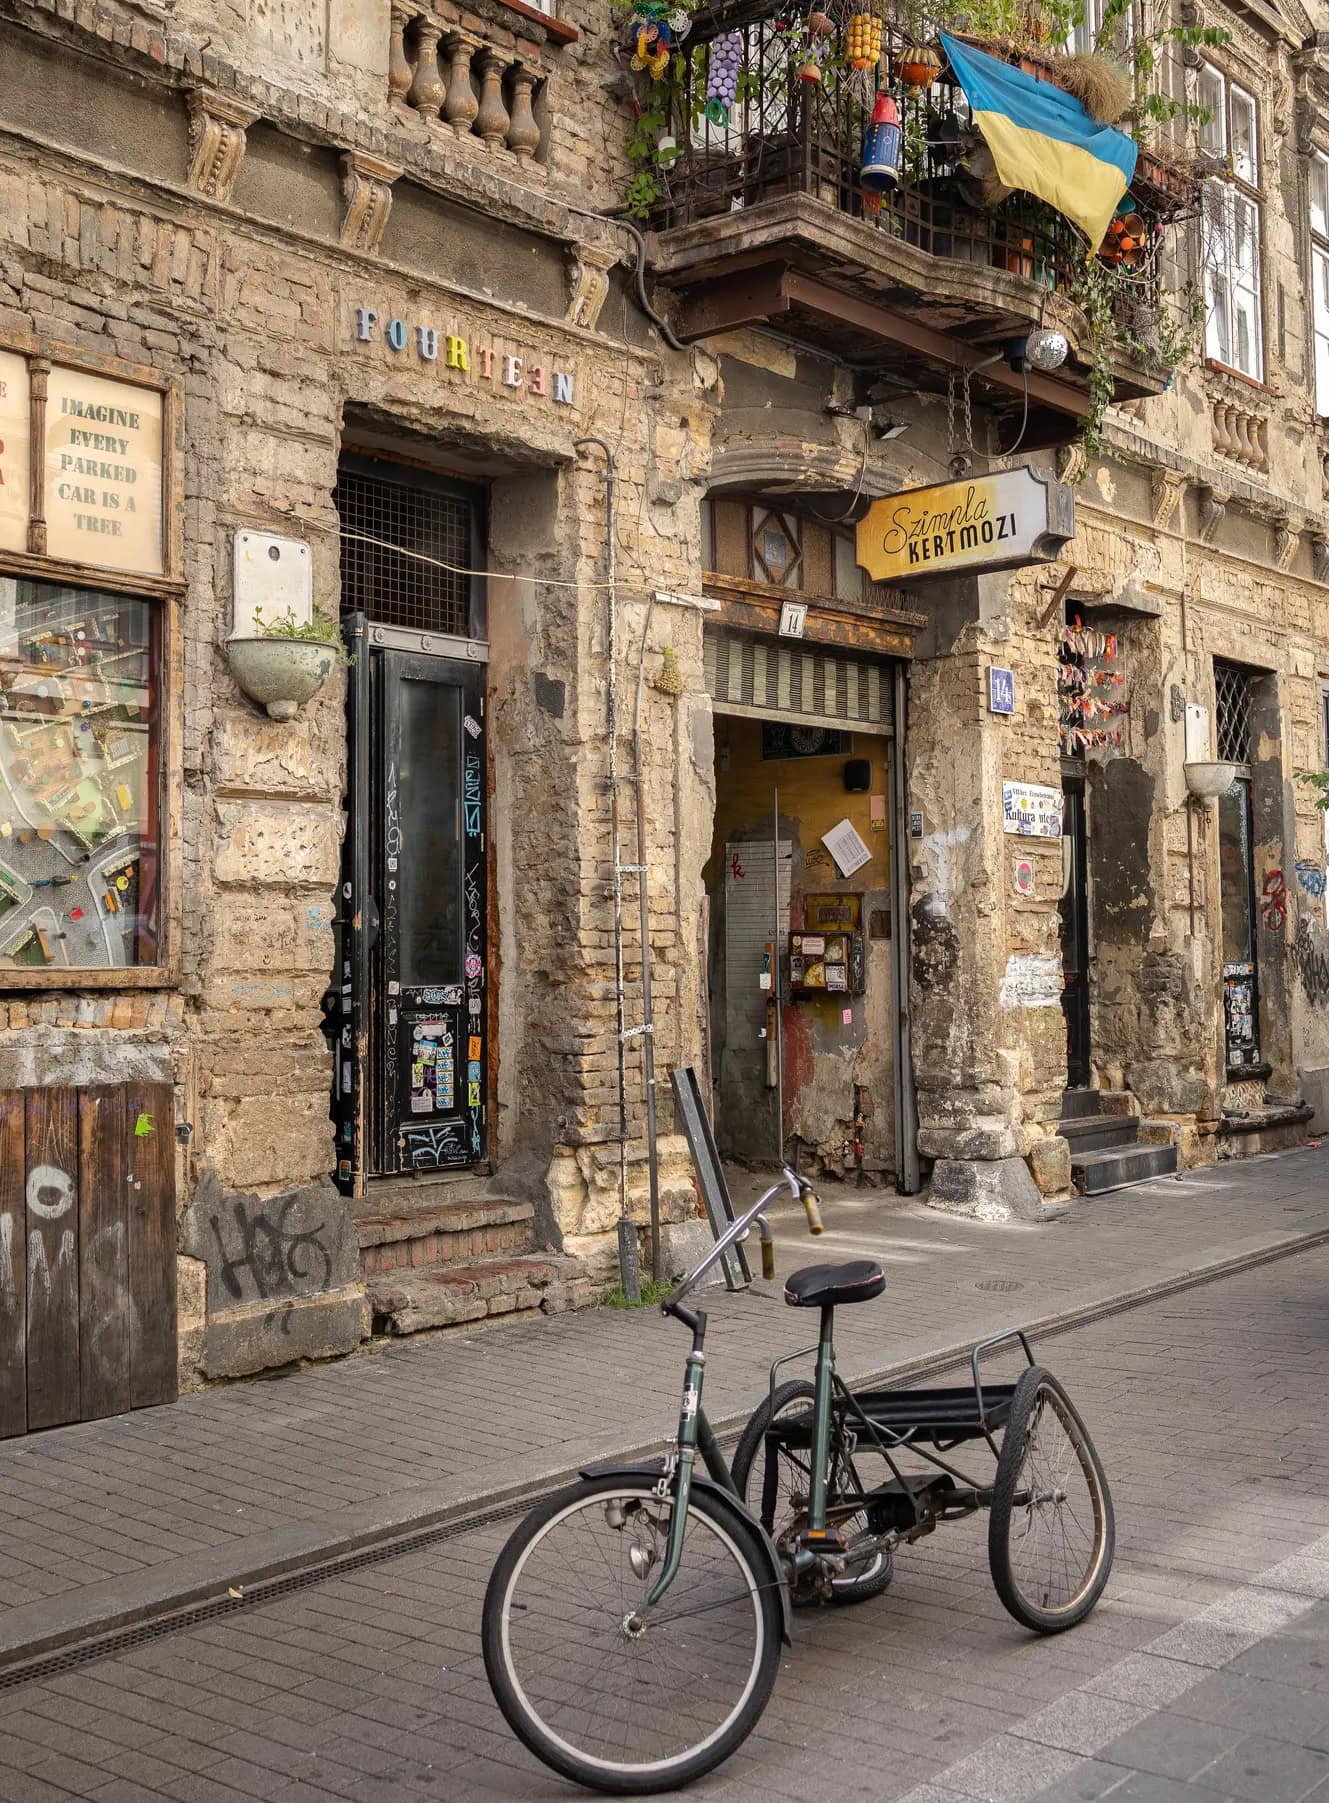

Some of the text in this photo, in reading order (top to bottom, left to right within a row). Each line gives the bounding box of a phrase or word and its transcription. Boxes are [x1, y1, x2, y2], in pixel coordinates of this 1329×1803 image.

[61, 397, 140, 430] IMAGINE
[70, 428, 130, 456] EVERY
[60, 453, 137, 484] PARKED
[58, 483, 136, 513] CAR IS A
[73, 513, 123, 537] TREE
[883, 486, 990, 554] Szimpla
[909, 512, 1017, 564] KERTMOZI
[787, 612, 800, 634] 14
[995, 677, 1012, 705] 14
